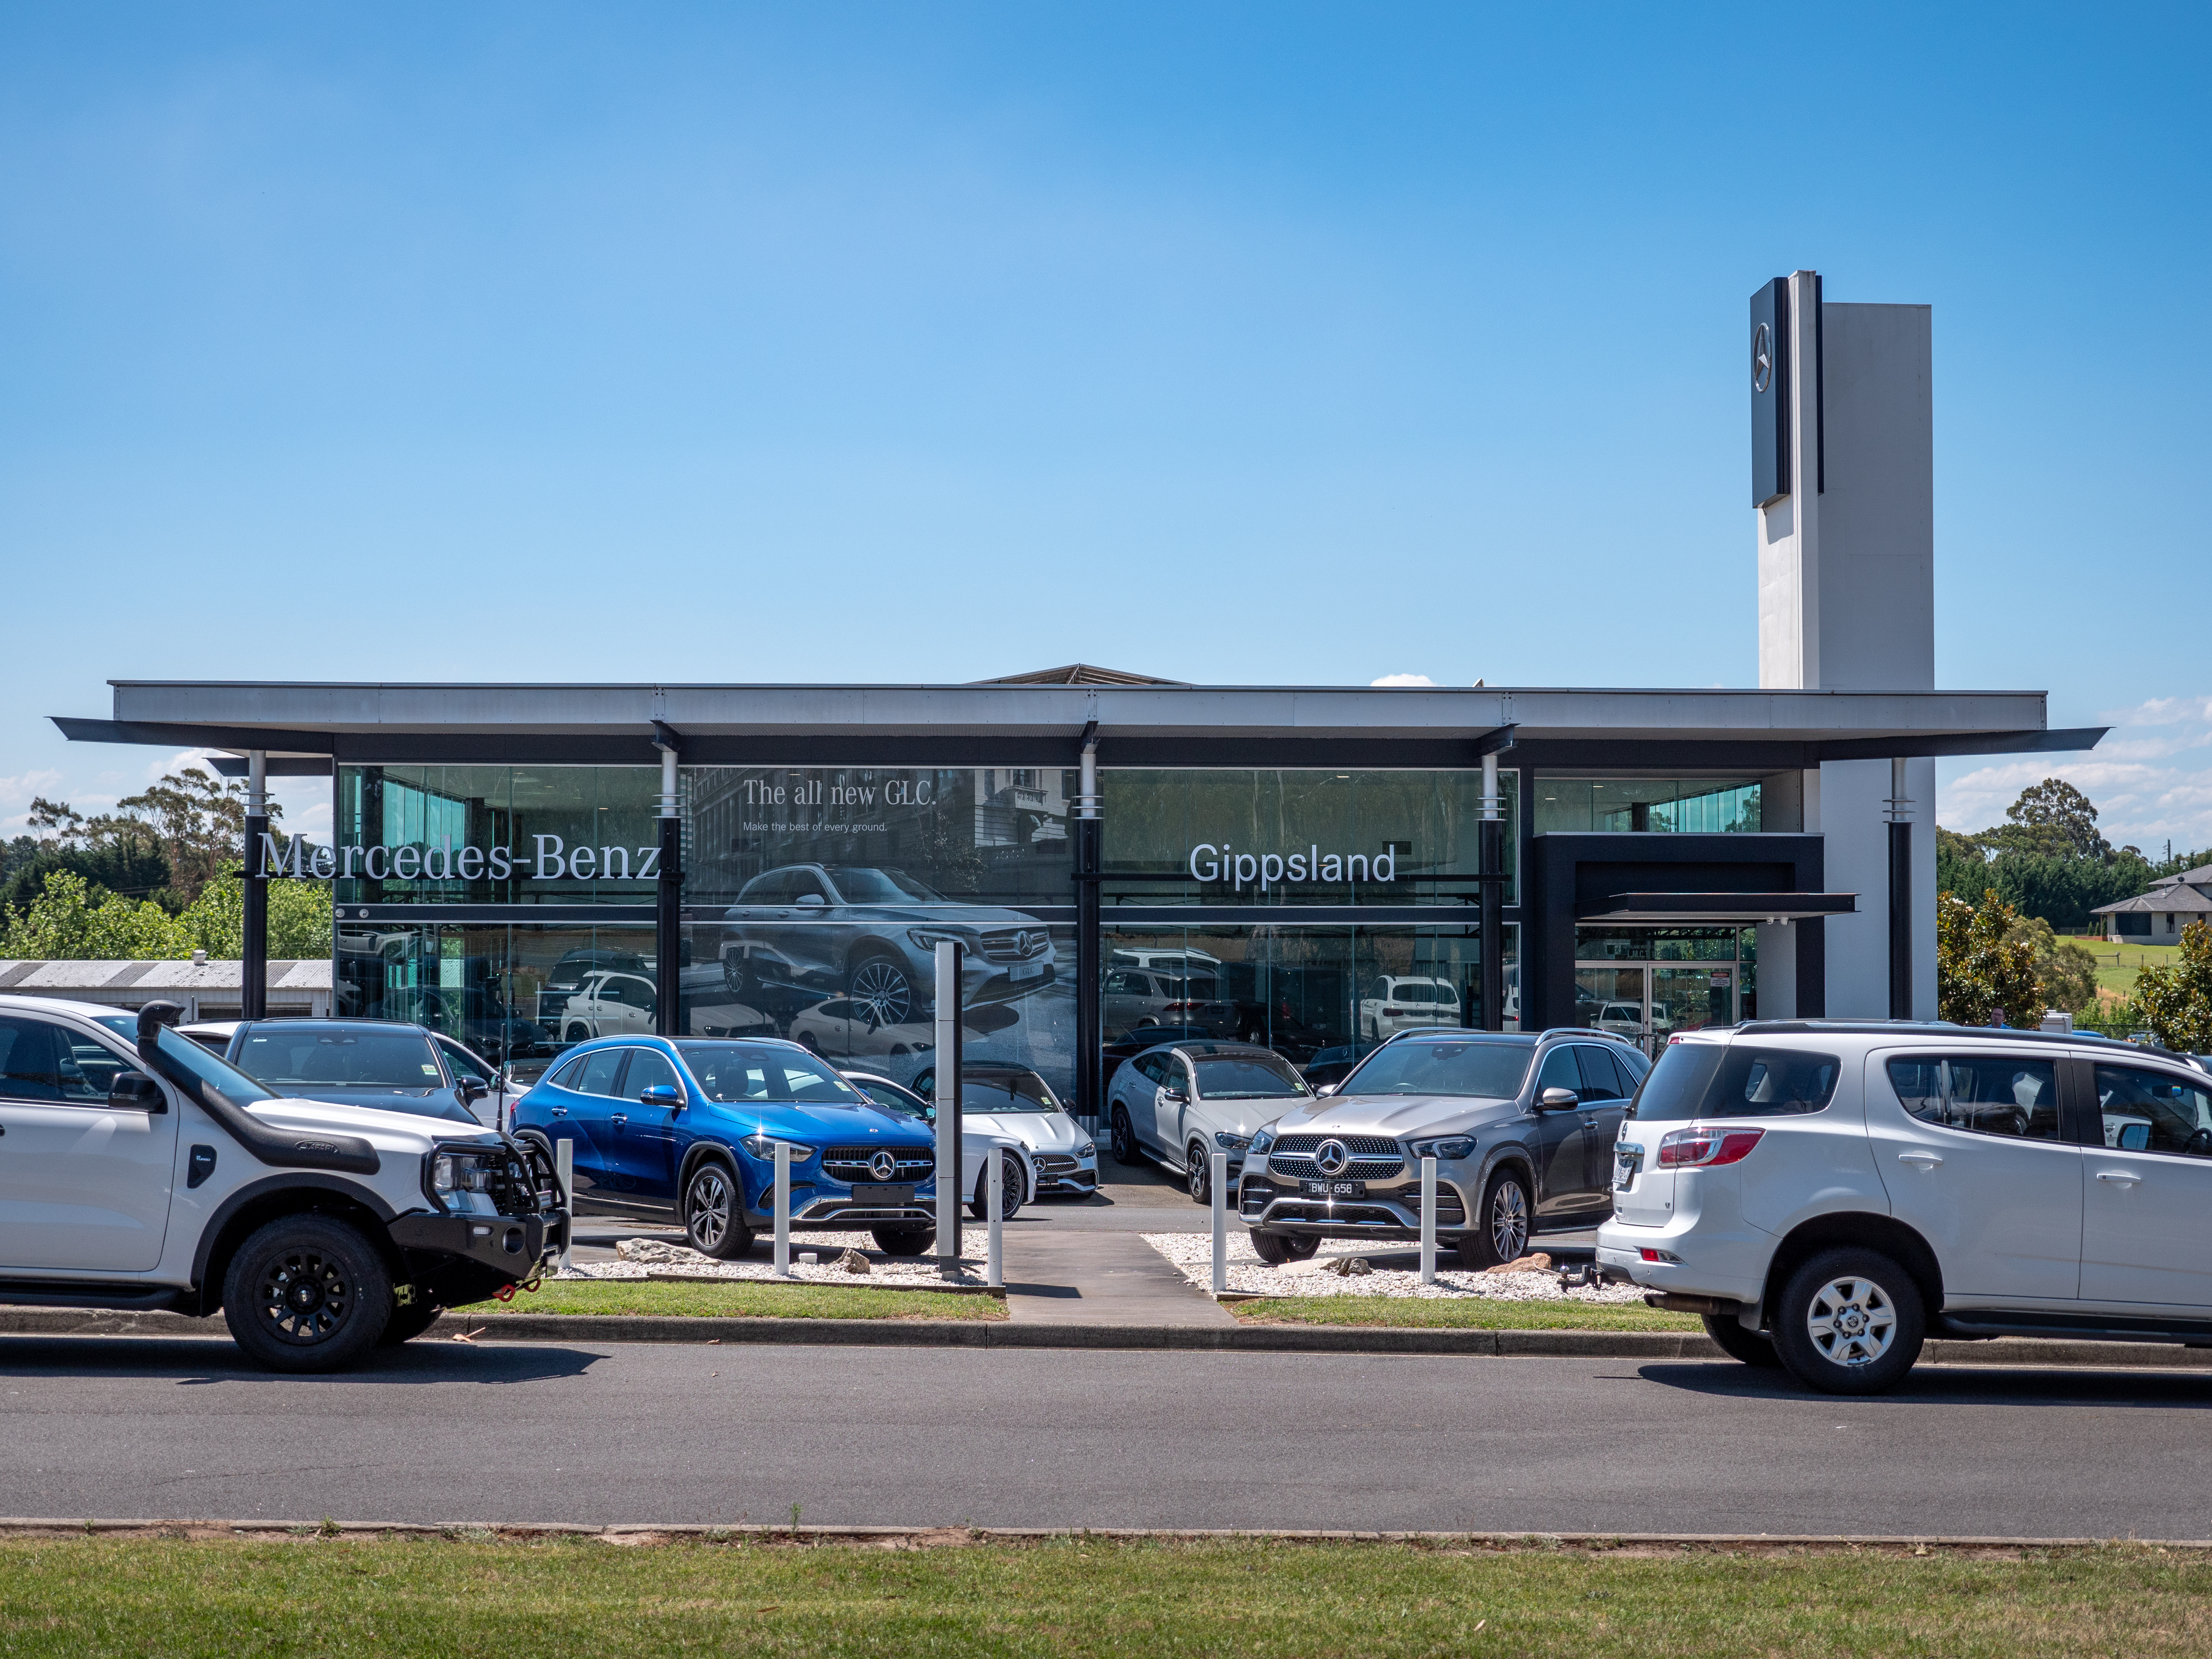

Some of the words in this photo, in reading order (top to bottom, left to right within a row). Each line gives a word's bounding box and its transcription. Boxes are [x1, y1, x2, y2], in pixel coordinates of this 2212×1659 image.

[743, 780, 785, 805] The
[794, 780, 822, 805] all
[830, 786, 877, 805] new
[885, 780, 936, 805] GLC.
[743, 822, 769, 831] Make
[772, 822, 786, 831] the
[789, 822, 809, 831] best
[812, 822, 822, 831] of
[824, 824, 849, 833] every
[852, 822, 887, 833] ground.
[255, 832, 662, 880] Mercedes-Benz
[1190, 844, 1395, 891] Gippsland
[1023, 967, 1035, 975] GLC
[299, 1142, 335, 1152] SAFARI
